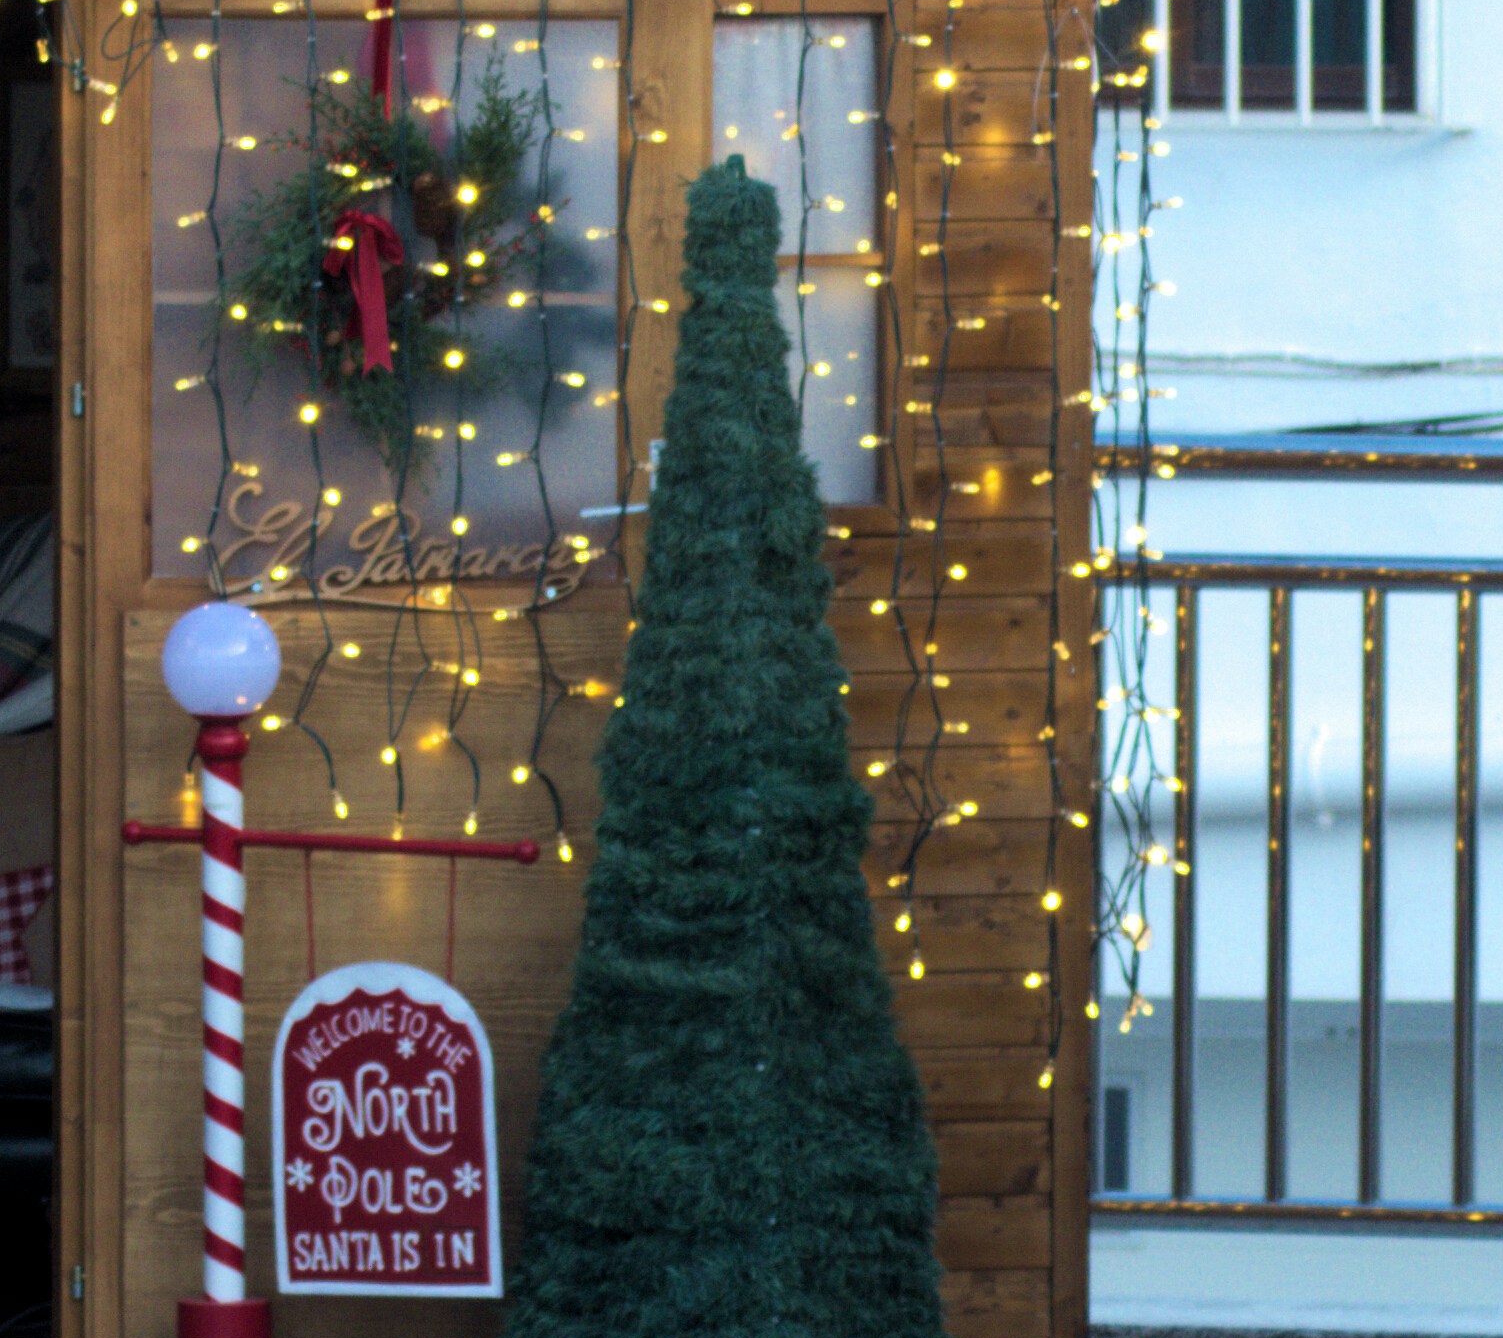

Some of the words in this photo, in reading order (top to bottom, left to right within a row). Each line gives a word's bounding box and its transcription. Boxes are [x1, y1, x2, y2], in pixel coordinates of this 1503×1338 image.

[208, 482, 333, 595] El
[318, 509, 592, 597] Patriarca
[292, 1002, 395, 1073] WELCOME
[397, 1004, 428, 1039] TO
[426, 1022, 473, 1074] THE
[302, 1061, 457, 1155] NORTH
[321, 1155, 449, 1225] POLE
[294, 1230, 385, 1272] SANTA
[392, 1231, 420, 1272] IS
[434, 1230, 475, 1270] IN
